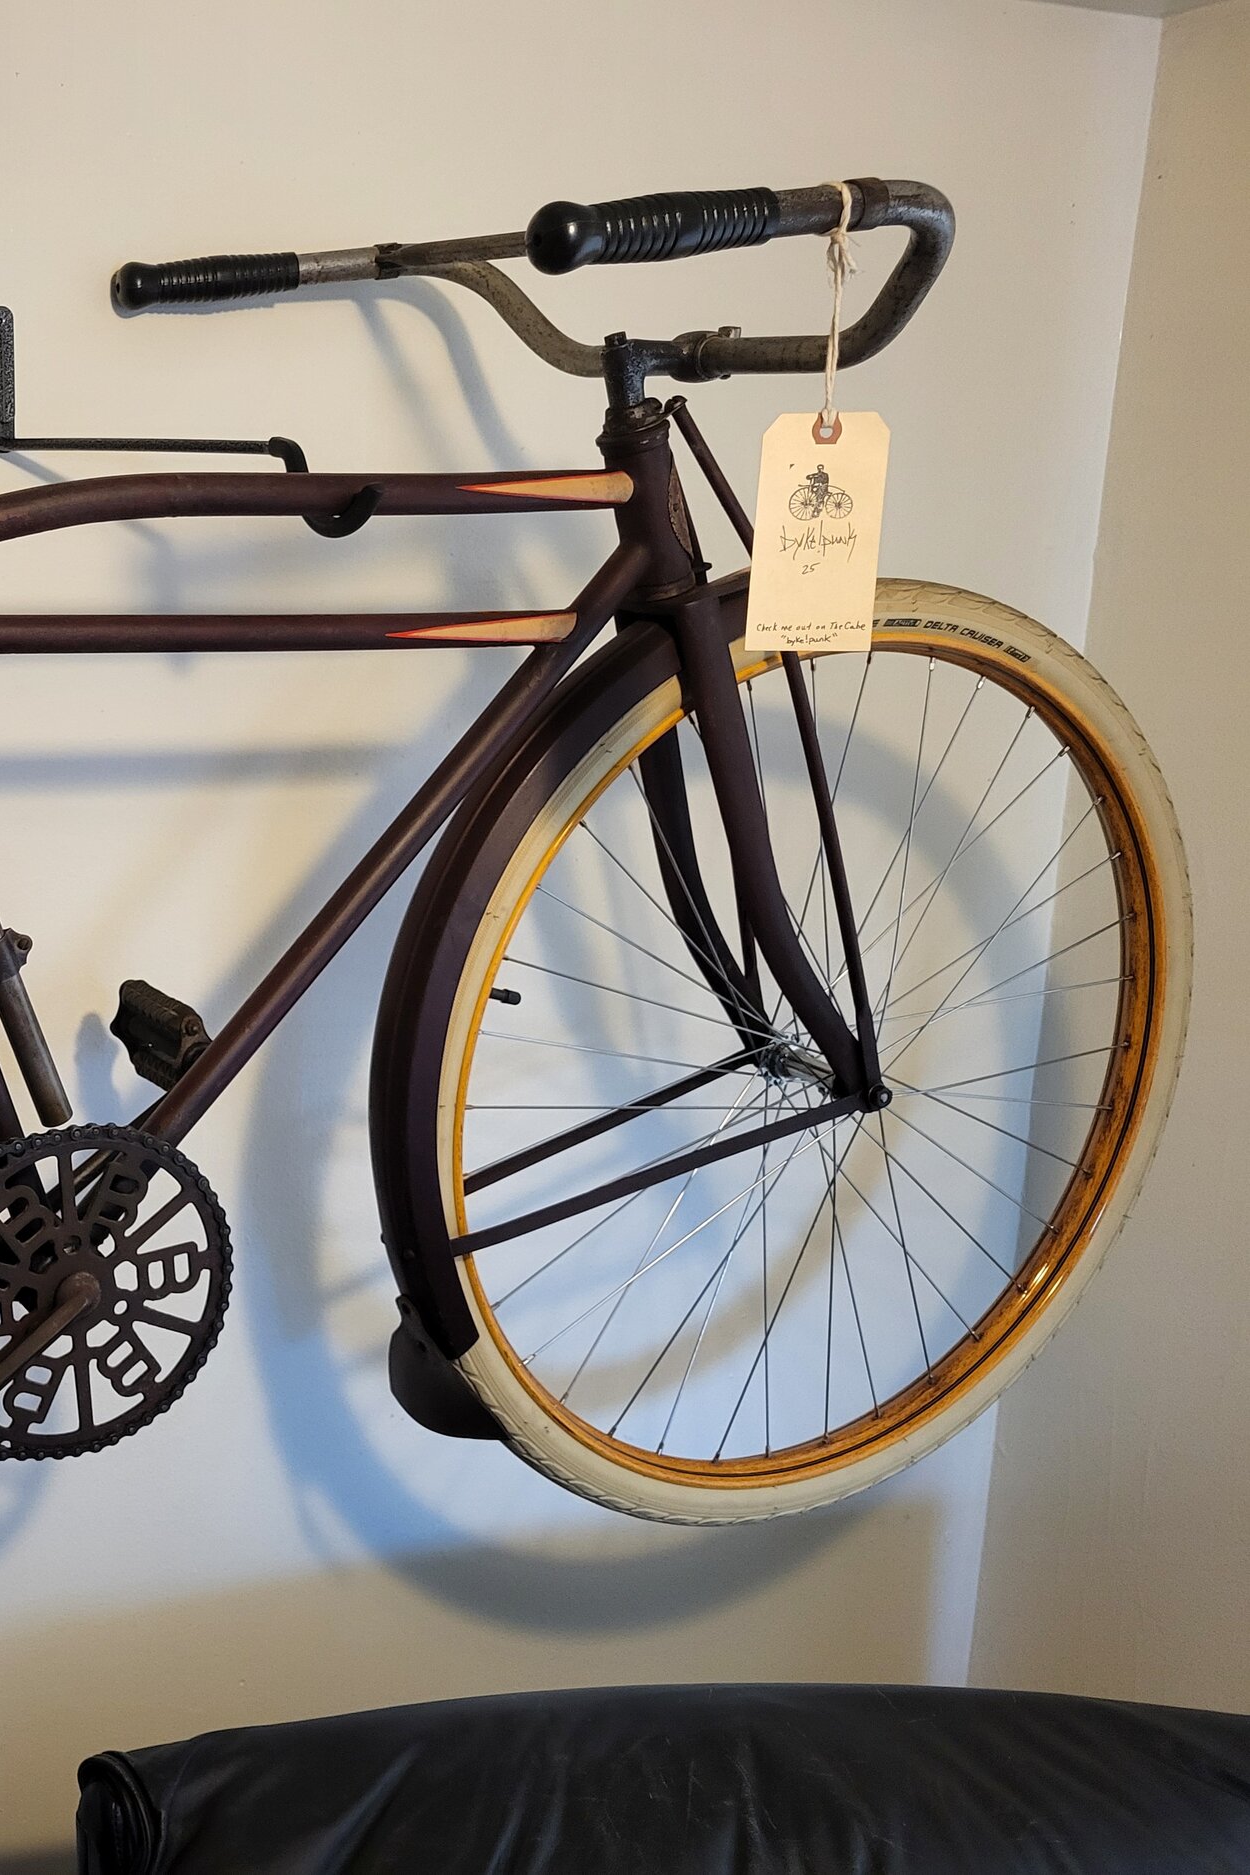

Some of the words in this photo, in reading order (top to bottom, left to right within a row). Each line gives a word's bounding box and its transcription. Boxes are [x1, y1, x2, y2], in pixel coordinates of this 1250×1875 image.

[801, 562, 821, 575] 25
[795, 622, 812, 631] out
[923, 620, 960, 633] DELTA
[959, 627, 1005, 650] CRUISER
